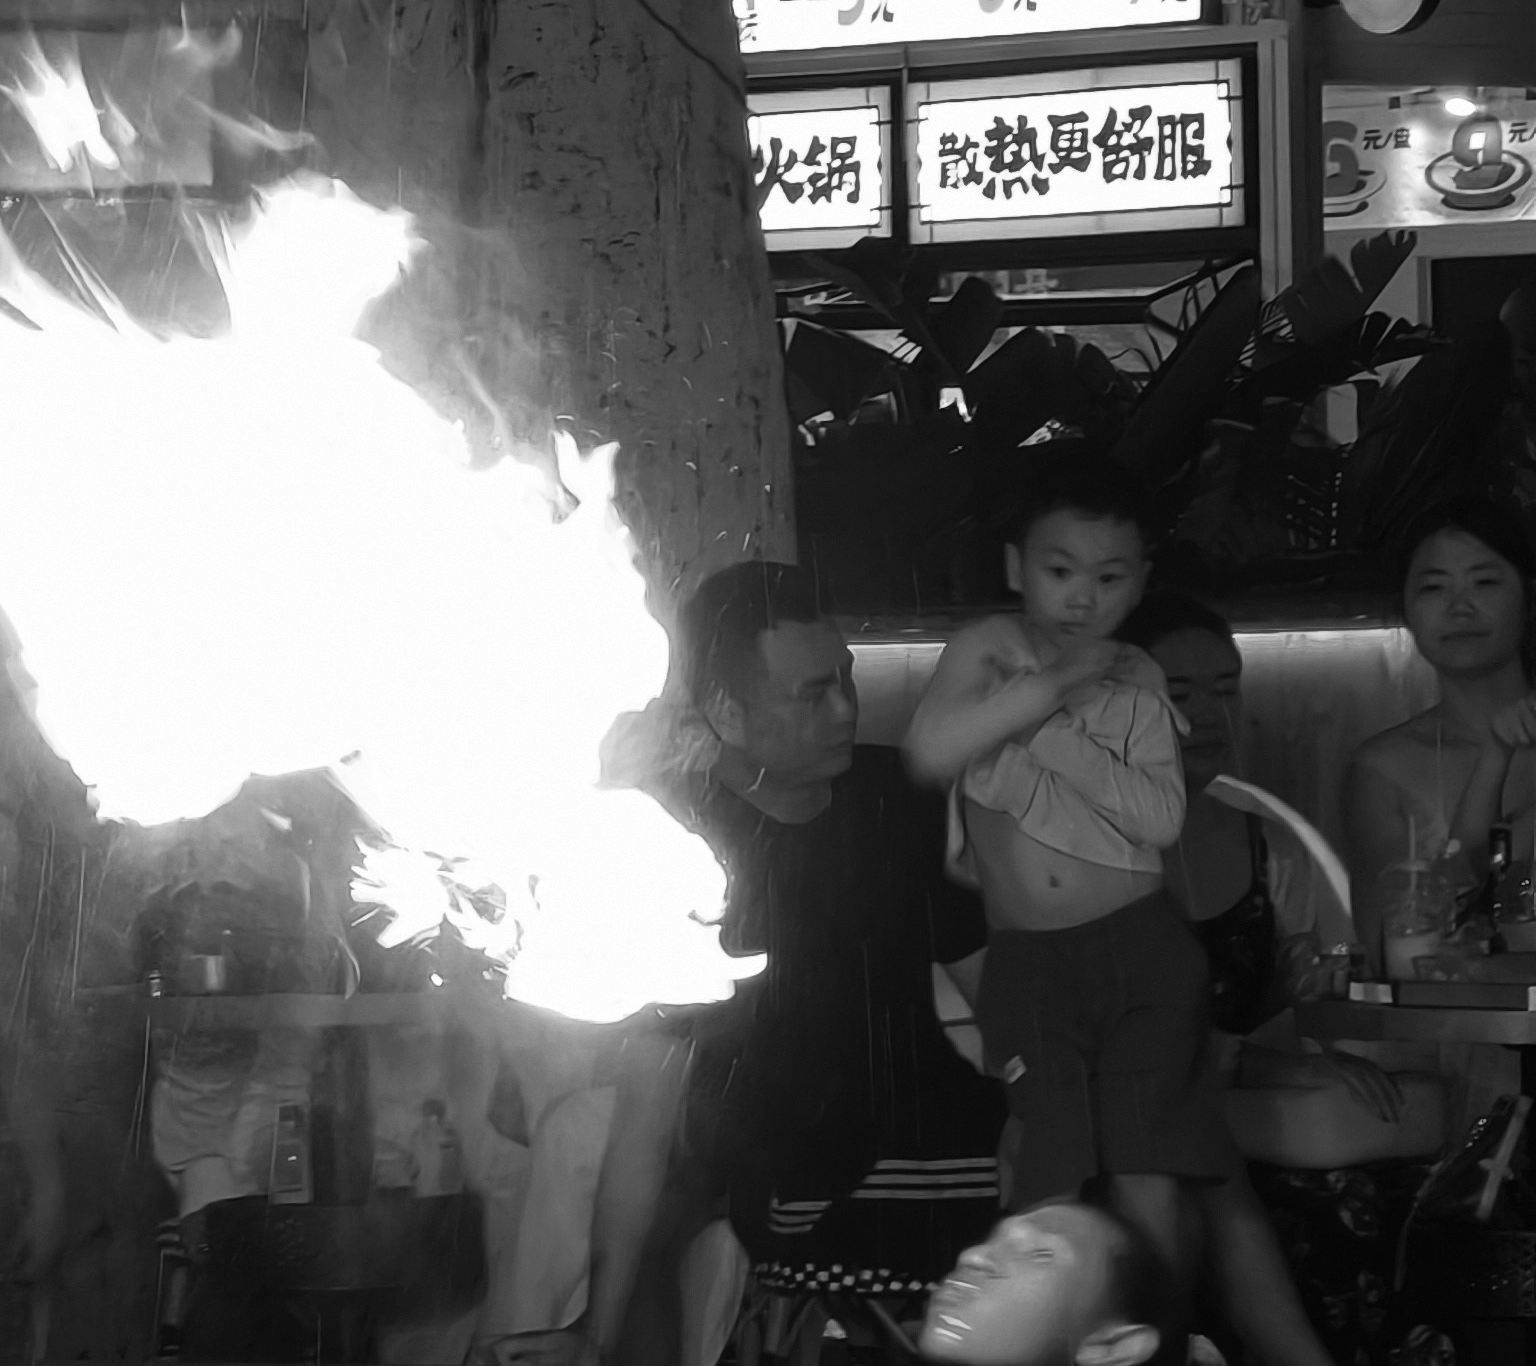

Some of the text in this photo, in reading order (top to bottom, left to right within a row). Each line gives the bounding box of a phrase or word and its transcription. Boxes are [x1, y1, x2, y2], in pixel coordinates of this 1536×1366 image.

[751, 135, 861, 205] 火锅
[938, 105, 1212, 200] 散热更舒服
